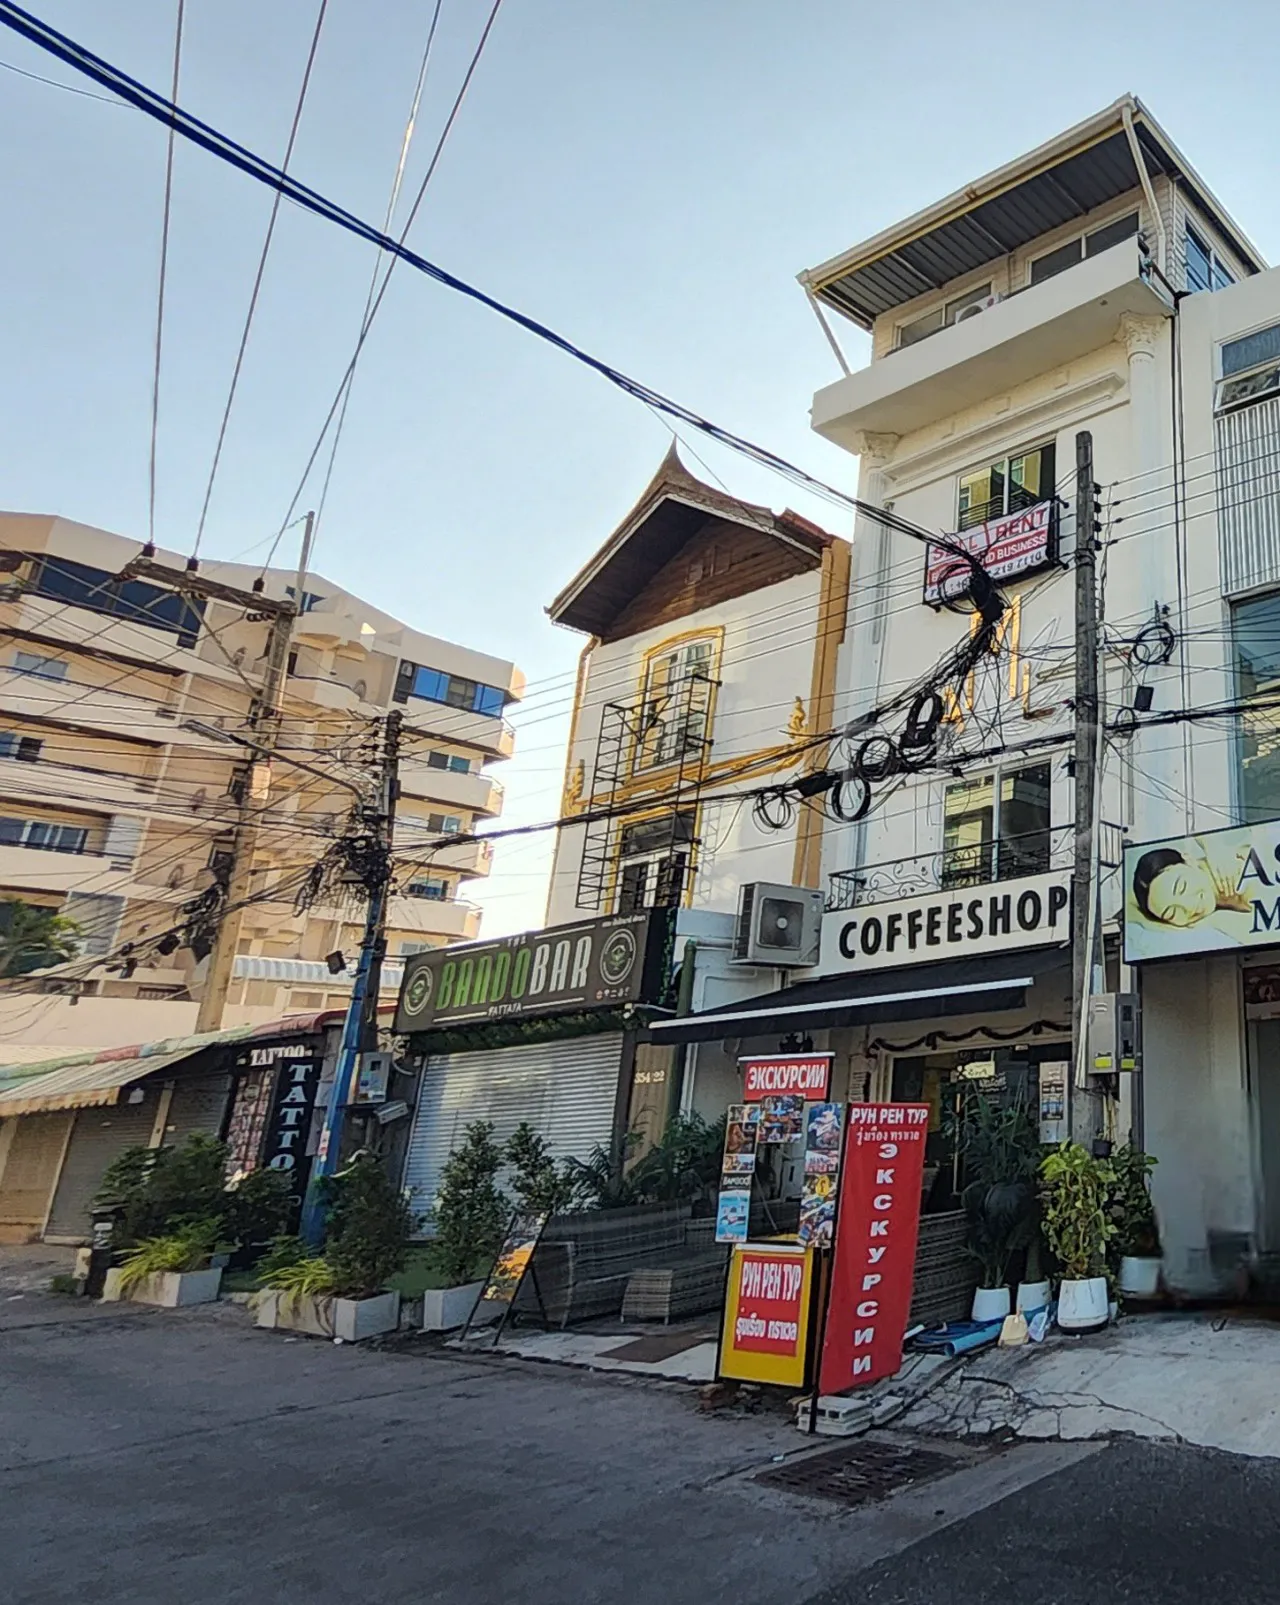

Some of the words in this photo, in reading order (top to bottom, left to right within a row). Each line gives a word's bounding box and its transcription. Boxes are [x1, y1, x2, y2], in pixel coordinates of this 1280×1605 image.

[995, 507, 1048, 538] RENT
[997, 534, 1047, 559] BUSINESS
[838, 885, 1068, 960] COFFEESHOP
[250, 1044, 306, 1067] TATTOO
[747, 1064, 827, 1092] ЭКСКУРСИИ
[270, 1063, 314, 1185] TATTO
[850, 1107, 877, 1125] РУН
[879, 1107, 905, 1125] РЕН
[906, 1108, 929, 1125] ТУР
[852, 1142, 898, 1376] ЭКСКУРСИИ
[740, 1261, 762, 1298] РУН
[761, 1262, 782, 1300] РЕН
[782, 1263, 802, 1301] ТУР
